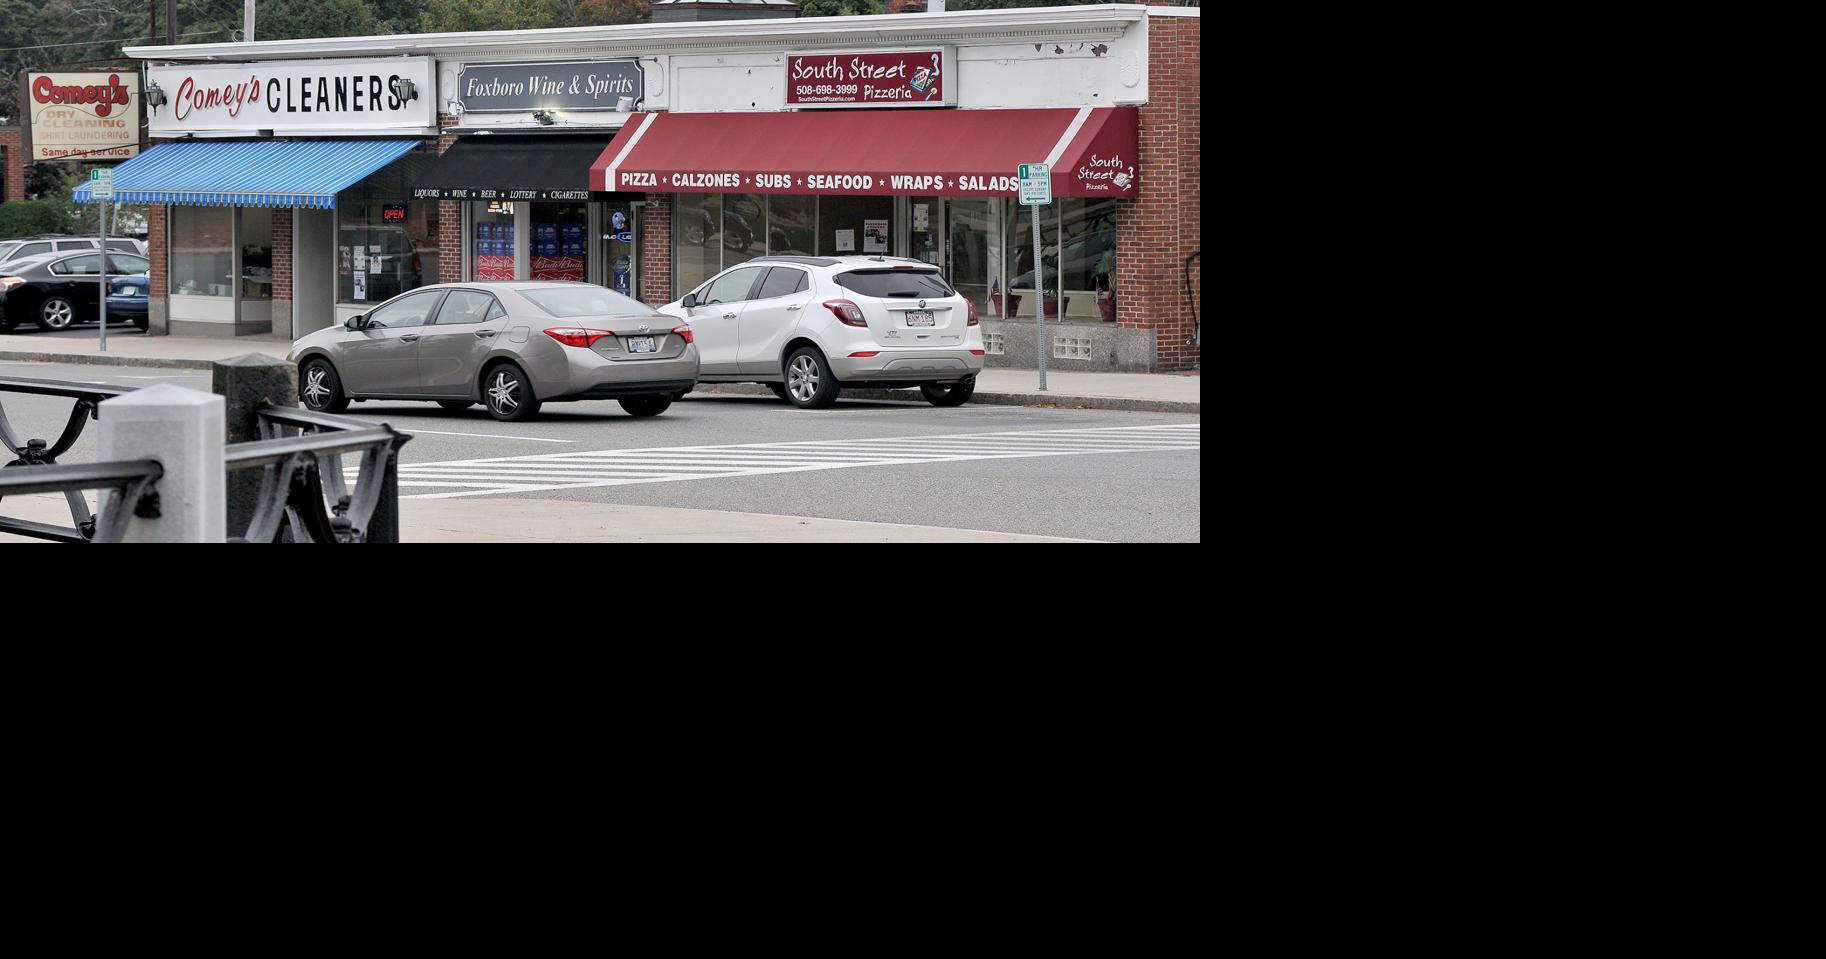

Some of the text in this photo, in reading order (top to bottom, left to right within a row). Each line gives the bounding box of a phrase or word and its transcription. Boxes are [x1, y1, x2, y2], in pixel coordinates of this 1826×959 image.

[792, 56, 906, 81] South Street
[466, 73, 634, 99] Foxboro Wine & Spirits
[796, 84, 858, 95] 508-698-3999
[864, 84, 912, 100] Pizzeria
[32, 73, 129, 117] Comey's
[175, 74, 401, 121] Comey's CLEANERS
[46, 110, 76, 119] DRY
[42, 119, 126, 128] CLEANING
[69, 131, 129, 140] LAUNDERING
[41, 148, 68, 157] Same
[71, 148, 88, 158] day
[1090, 154, 1123, 169] South
[1078, 166, 1114, 180] Street
[621, 172, 1019, 191] PIZZA CALZONES SUBS SEAFOOD WRAPS SALADS
[414, 189, 588, 199] LIQUORS WINE BEER LOTTERY CIGARETTES
[384, 209, 405, 219] OPEN
